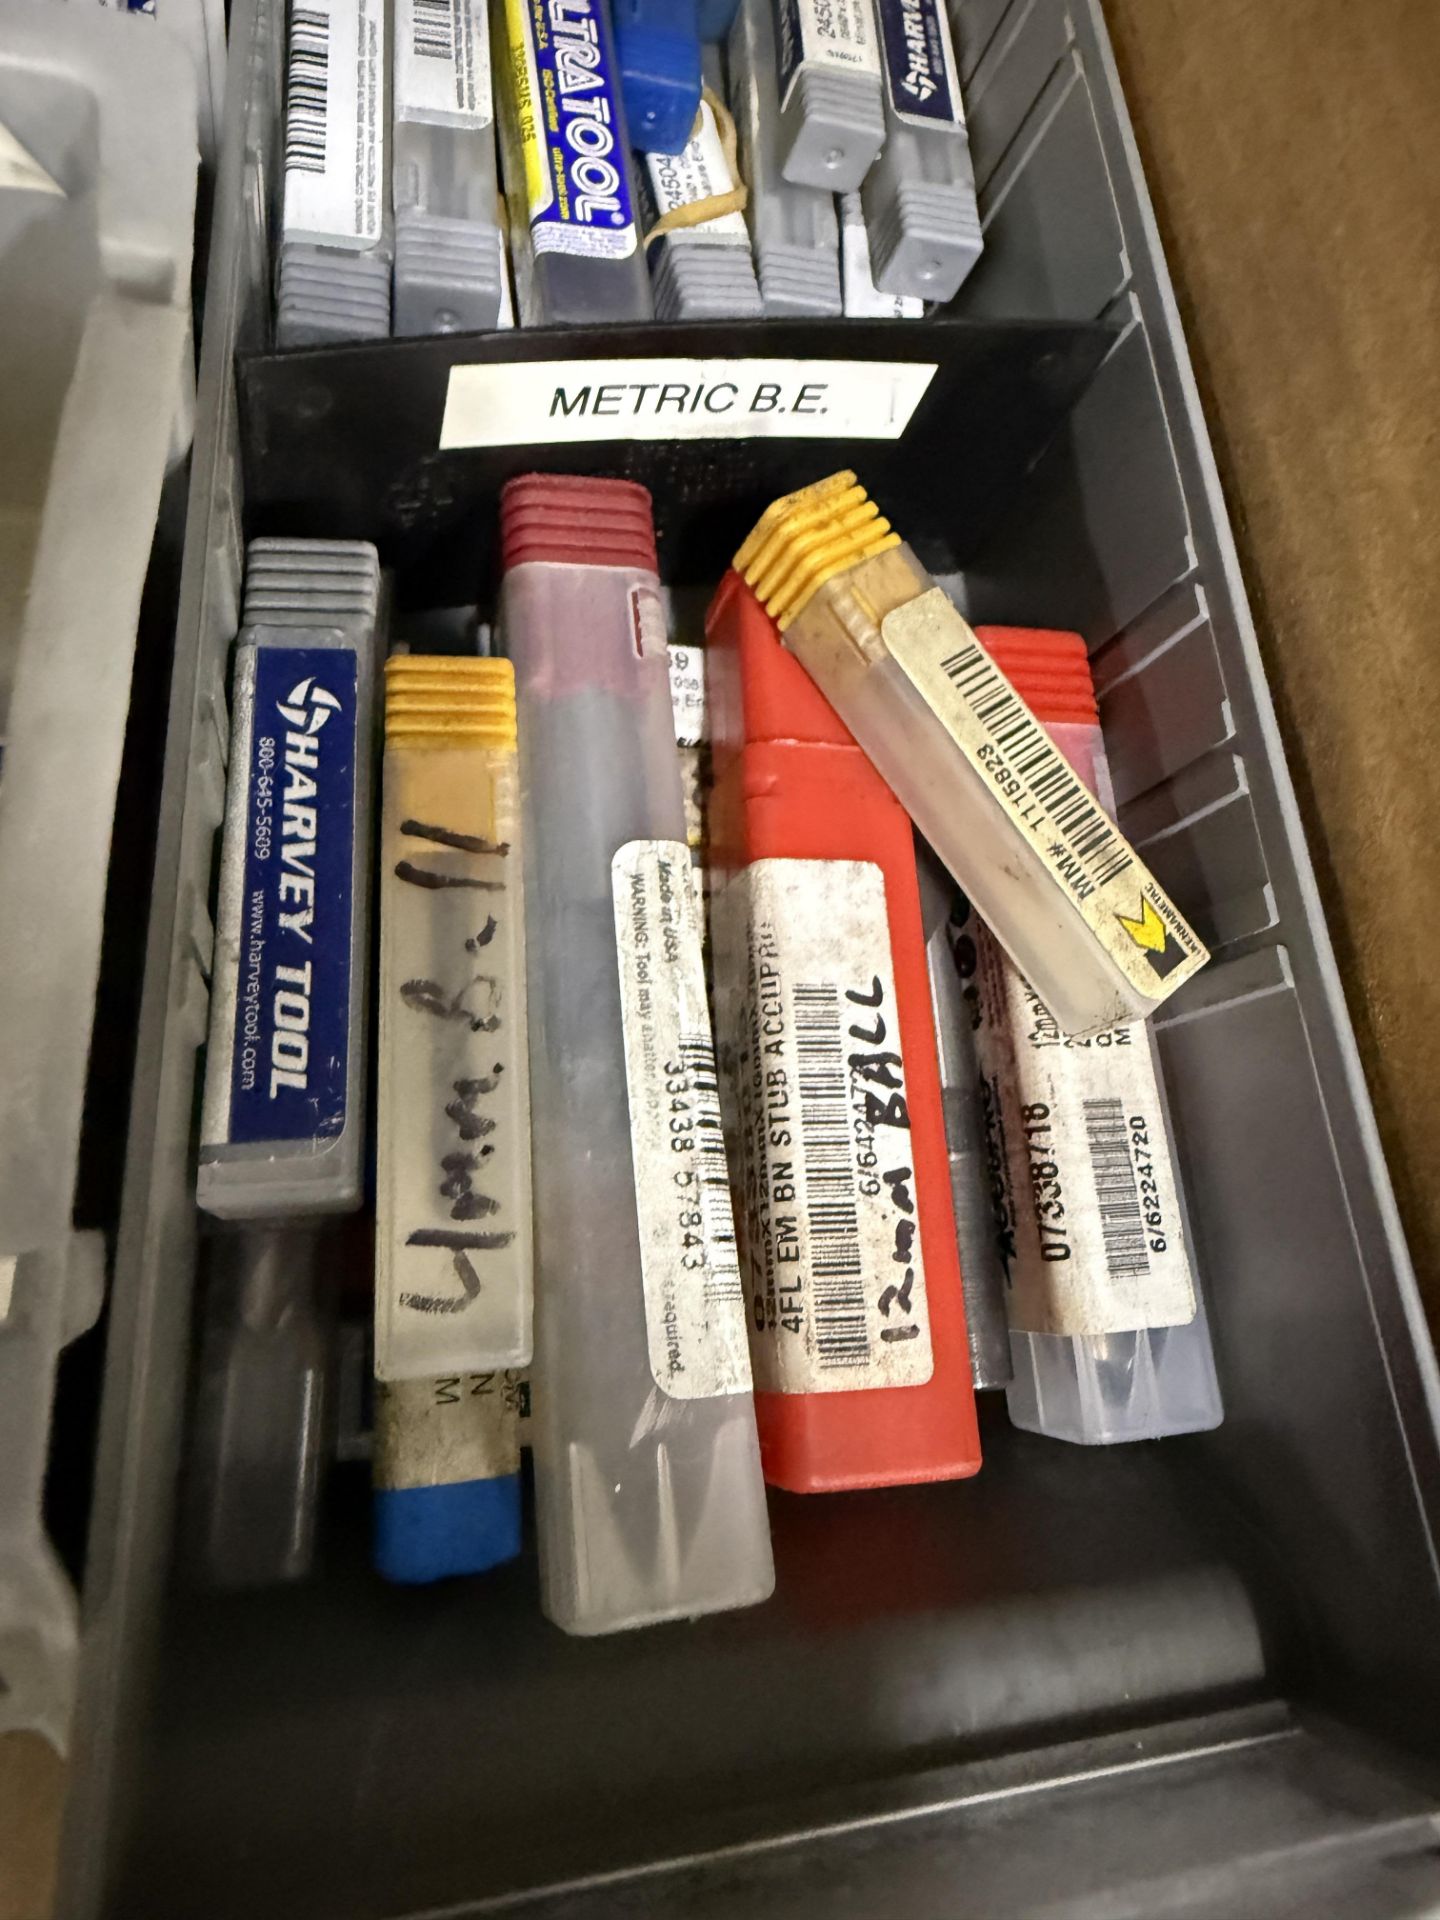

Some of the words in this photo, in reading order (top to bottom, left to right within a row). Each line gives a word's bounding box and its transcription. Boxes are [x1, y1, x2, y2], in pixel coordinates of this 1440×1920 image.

[549, 382, 738, 418] METRIC
[749, 383, 829, 414] B.E.
[255, 737, 275, 860] 800-645-5609
[976, 743, 1040, 831] 1115823
[278, 731, 319, 944] HARVEY
[629, 872, 650, 948] WARNING:
[663, 927, 678, 963] USA
[241, 888, 266, 1090] www.harveytool.com
[270, 960, 312, 1099] TOOL
[845, 974, 911, 1128] BALL
[766, 1068, 792, 1147] STUB
[772, 1161, 796, 1202] BN
[1129, 1115, 1168, 1253] 6/6224720
[776, 1216, 800, 1263] EM
[779, 1274, 804, 1333] 4FL
